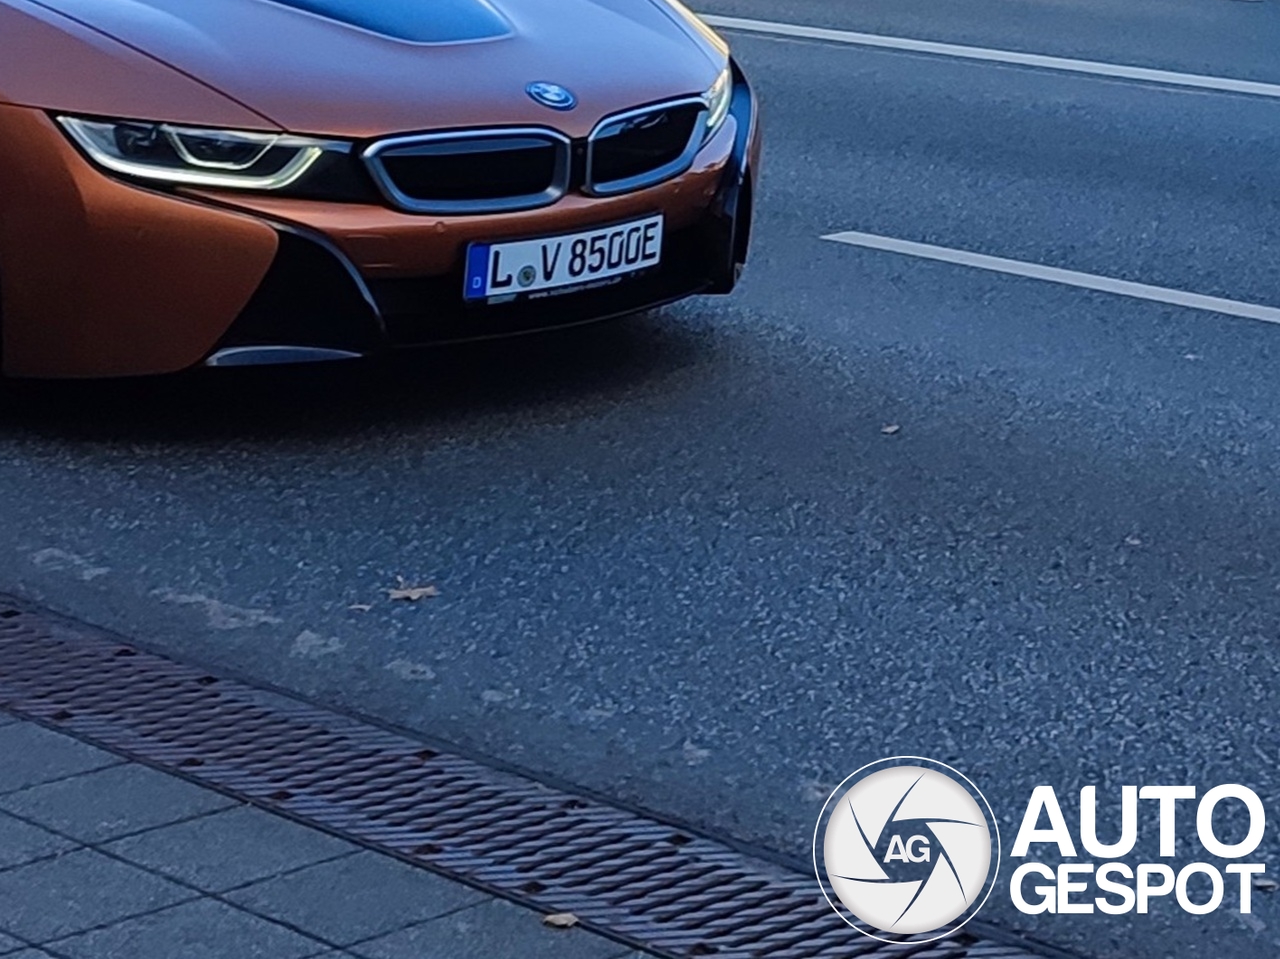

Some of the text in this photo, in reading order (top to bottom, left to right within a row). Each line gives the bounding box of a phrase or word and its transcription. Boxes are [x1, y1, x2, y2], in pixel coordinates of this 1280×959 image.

[490, 250, 512, 288] L
[541, 242, 562, 282] V
[568, 221, 659, 278] 8500E
[472, 276, 482, 289] D
